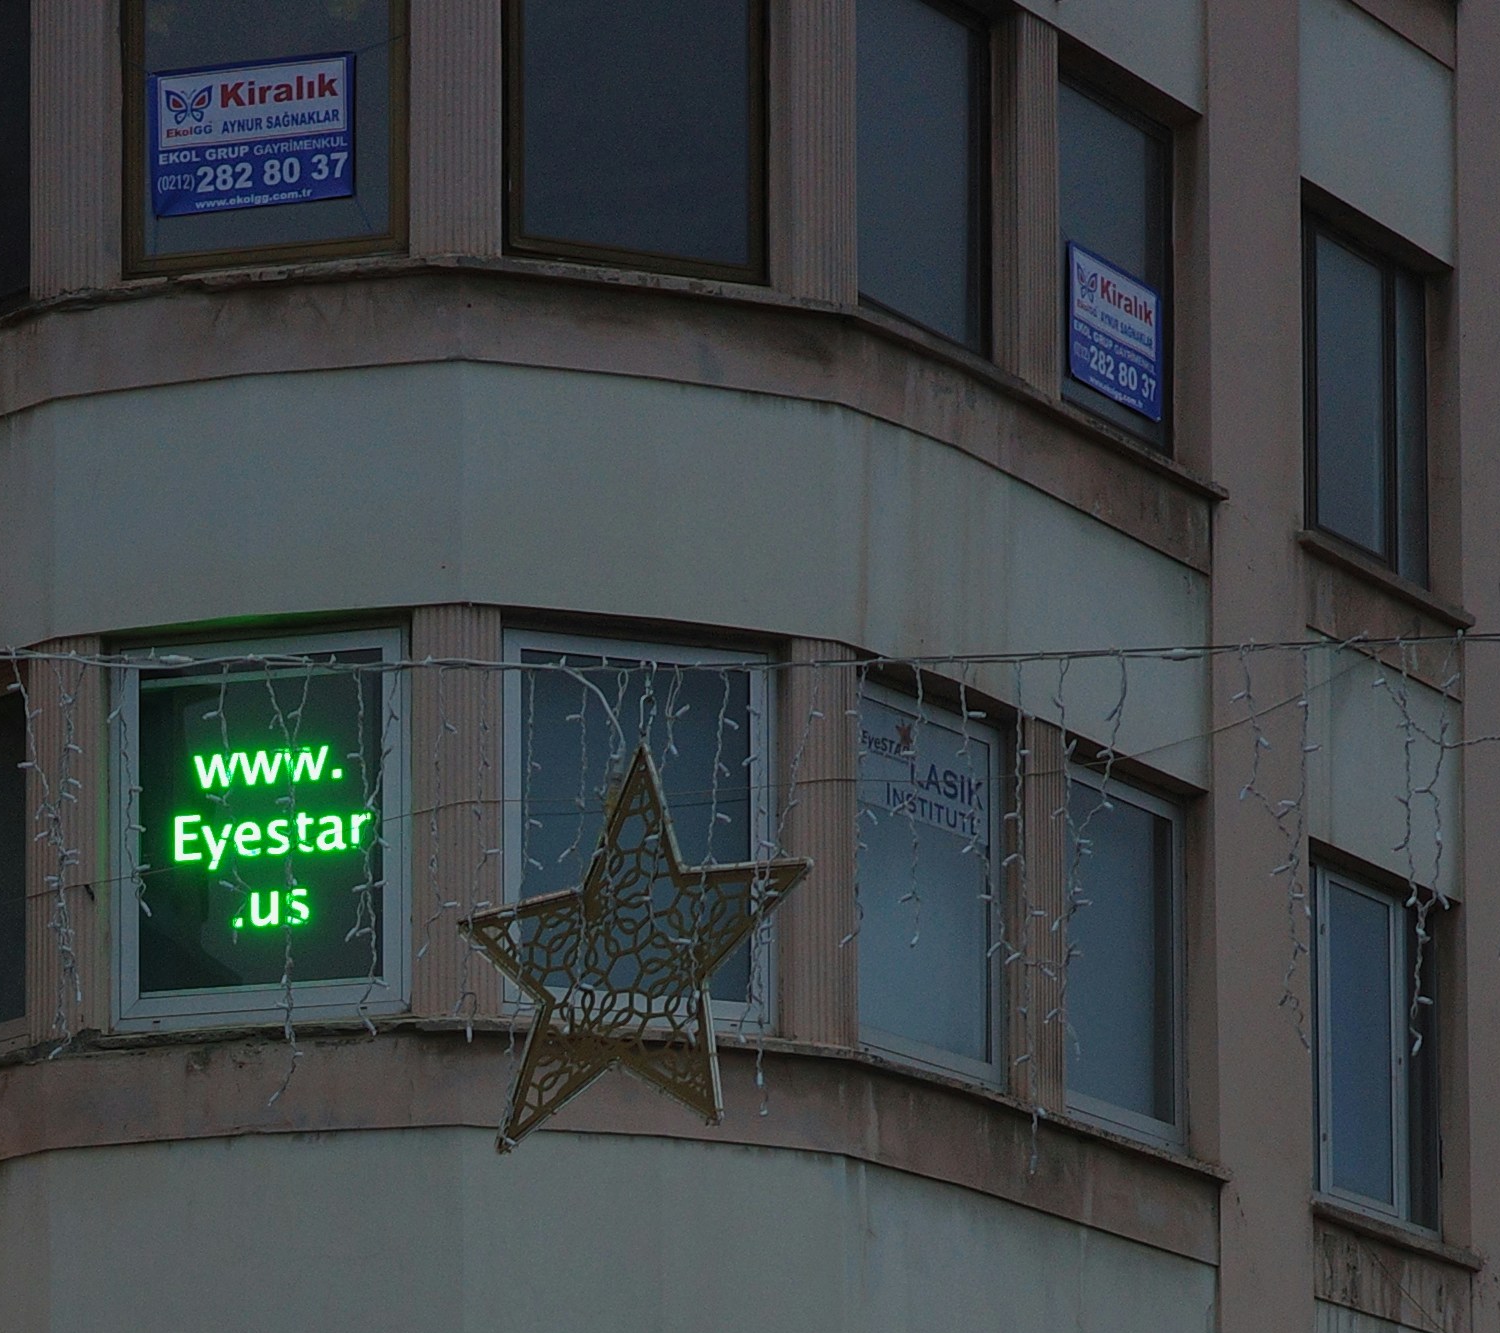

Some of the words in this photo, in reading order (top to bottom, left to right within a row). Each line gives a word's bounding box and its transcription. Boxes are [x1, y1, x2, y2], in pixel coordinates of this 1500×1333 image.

[220, 73, 338, 108] Kiralık
[166, 124, 213, 138] EkolGG
[222, 118, 262, 134] AYNUR
[266, 109, 339, 130] SAĞNAKLAR
[158, 150, 200, 165] EKOL
[205, 145, 249, 161] GRUP
[253, 135, 348, 156] GAYRİMENKUL
[157, 174, 195, 193] (0212)
[196, 162, 253, 193] 282
[263, 157, 301, 185] 80
[311, 151, 348, 181] 37
[1101, 276, 1153, 327] Kiralık
[1089, 345, 1115, 381] 282
[1118, 361, 1138, 391] 80
[1141, 373, 1156, 401] 37
[193, 745, 344, 790] www.
[910, 763, 984, 811] LASIK
[173, 811, 373, 871] Eyestar
[232, 888, 311, 929] .us
